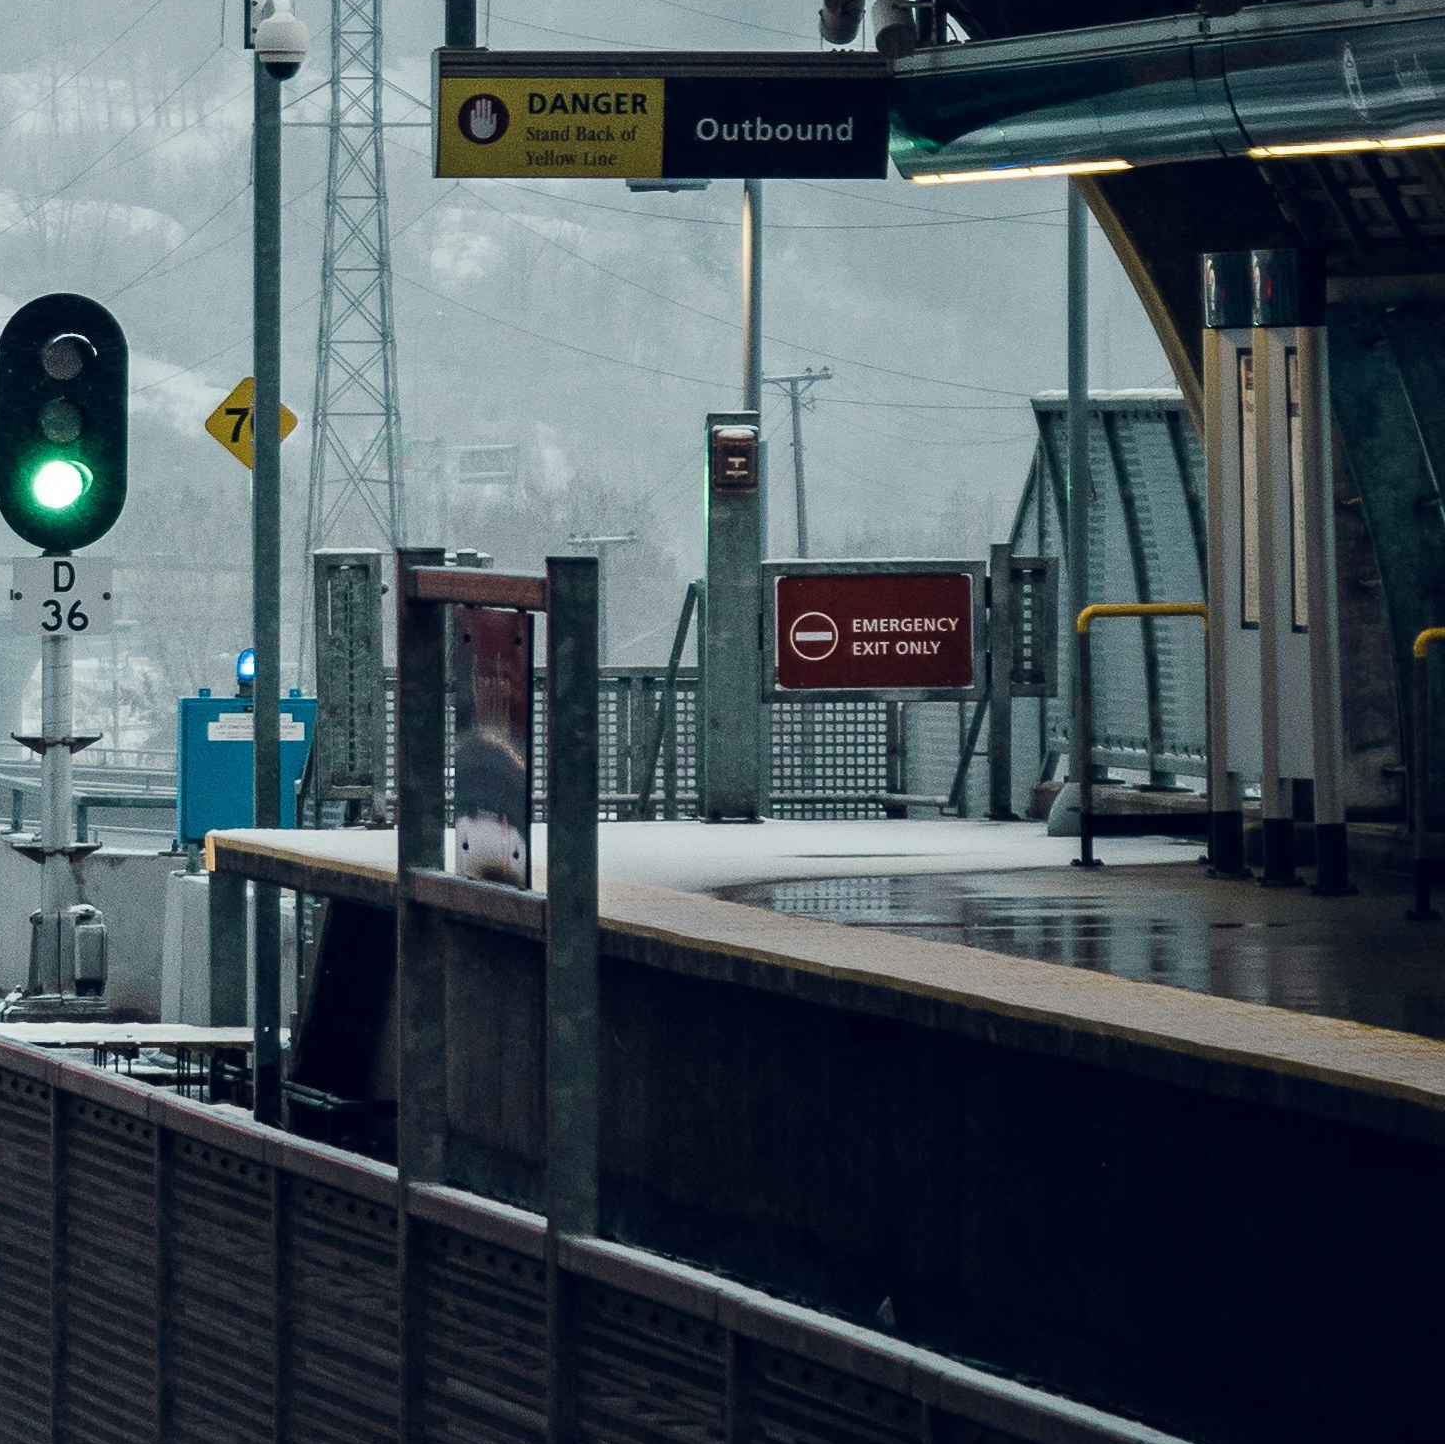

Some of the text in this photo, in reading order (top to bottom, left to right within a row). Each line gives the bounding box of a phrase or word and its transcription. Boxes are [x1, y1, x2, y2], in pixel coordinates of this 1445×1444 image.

[528, 92, 648, 116] DANGER
[526, 124, 638, 143] Stand Back of
[695, 116, 853, 142] Outbound
[525, 149, 618, 167] Yellow Line
[53, 560, 76, 593] D
[41, 599, 89, 632] 36
[851, 617, 959, 633] EMERGENCY
[852, 640, 942, 656] EXIT ONLY
